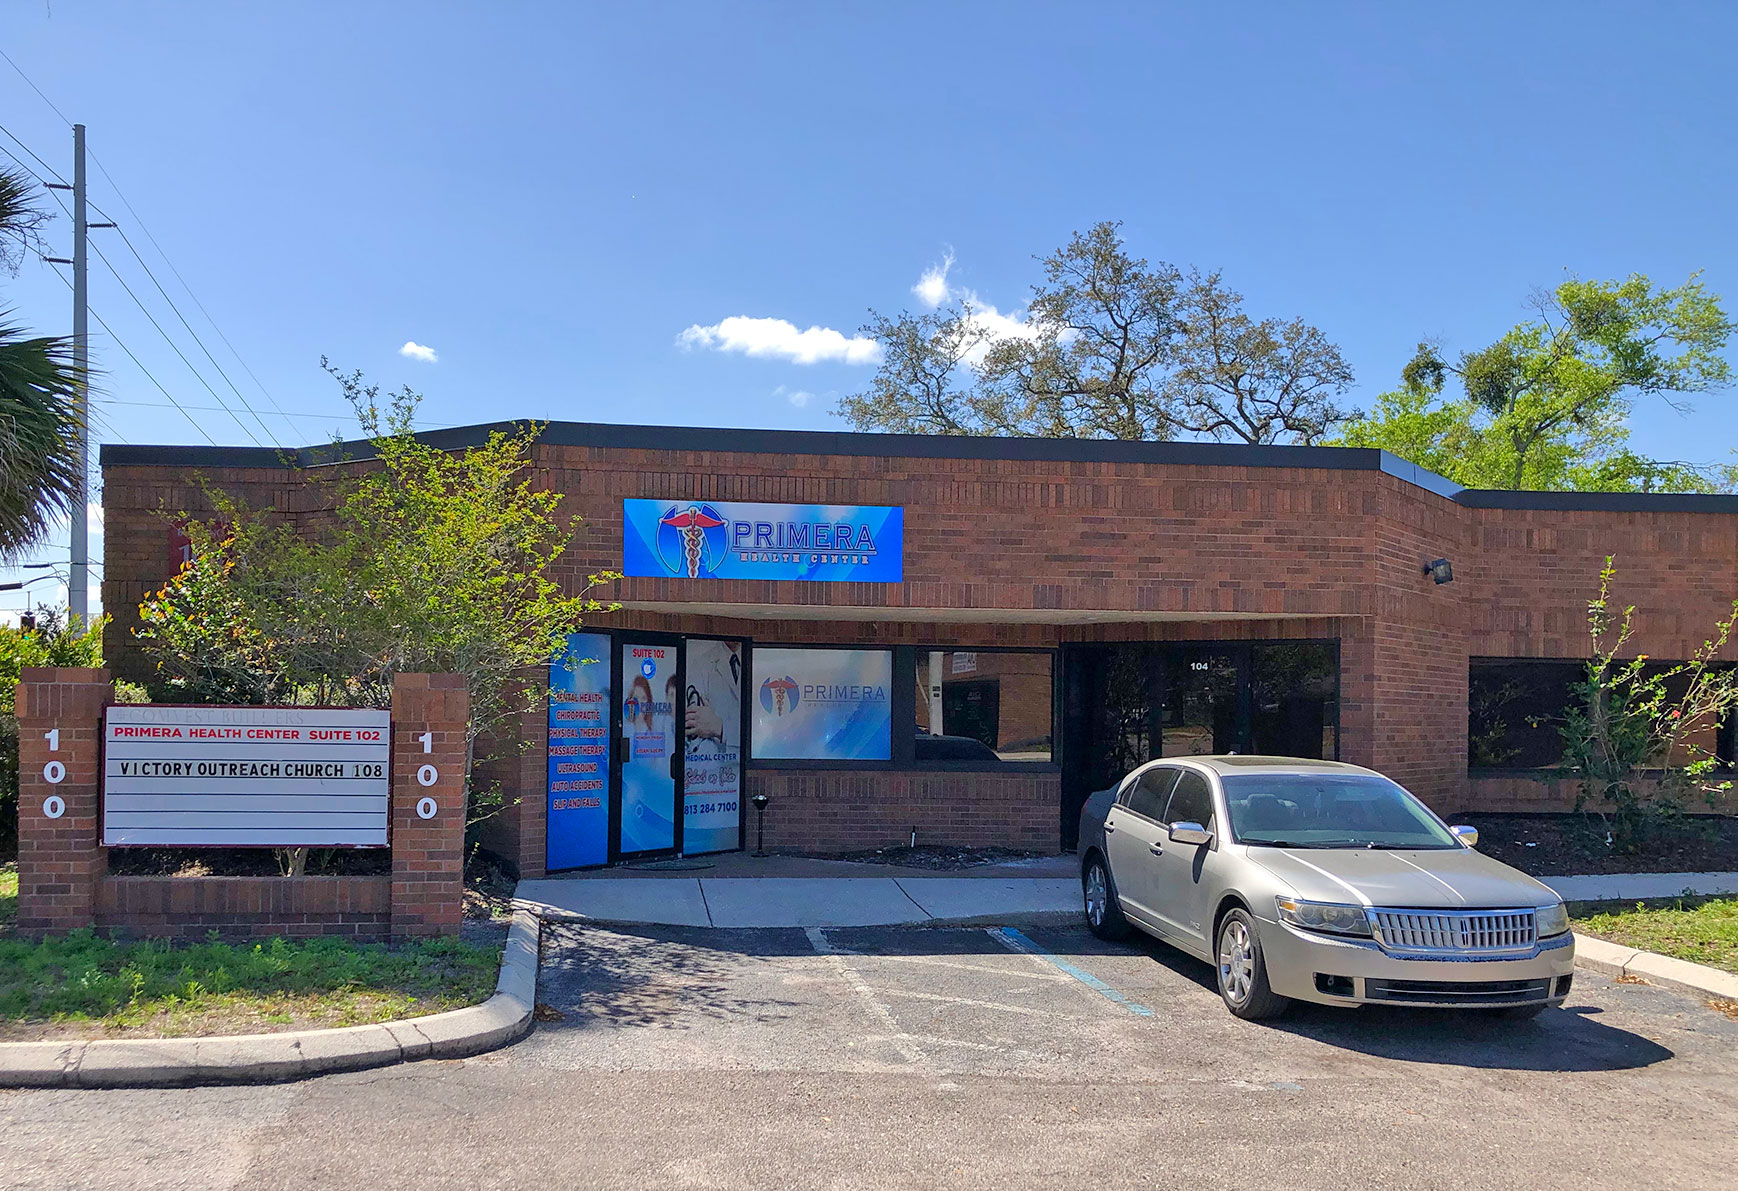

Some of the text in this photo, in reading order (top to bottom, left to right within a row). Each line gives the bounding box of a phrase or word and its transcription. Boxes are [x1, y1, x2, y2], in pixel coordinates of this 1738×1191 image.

[732, 521, 876, 550] PRIMERA
[740, 552, 870, 565] HEALTH CENTER
[632, 648, 665, 659] SUITE 102
[1190, 662, 1208, 671] 104
[579, 692, 603, 703] HEALTH
[803, 685, 886, 700] PRIMERA
[556, 710, 600, 720] CHIROPRACTIC
[114, 727, 380, 741] PRIMERA HEALTH CENTER SUITE 102
[549, 727, 607, 738] PHYSICAL THERAPY
[549, 745, 606, 756] MASSAGE THERAPY
[685, 753, 737, 762] MEDICAL CENTER
[120, 762, 383, 777] VICTORY OUTREACH CHURCH 108
[557, 762, 598, 774] ULTRASOUND
[551, 779, 603, 792] AUTO ACCIDENTS
[553, 797, 601, 810] SLIP AND FALLS
[684, 801, 737, 815] 813 284 7100
